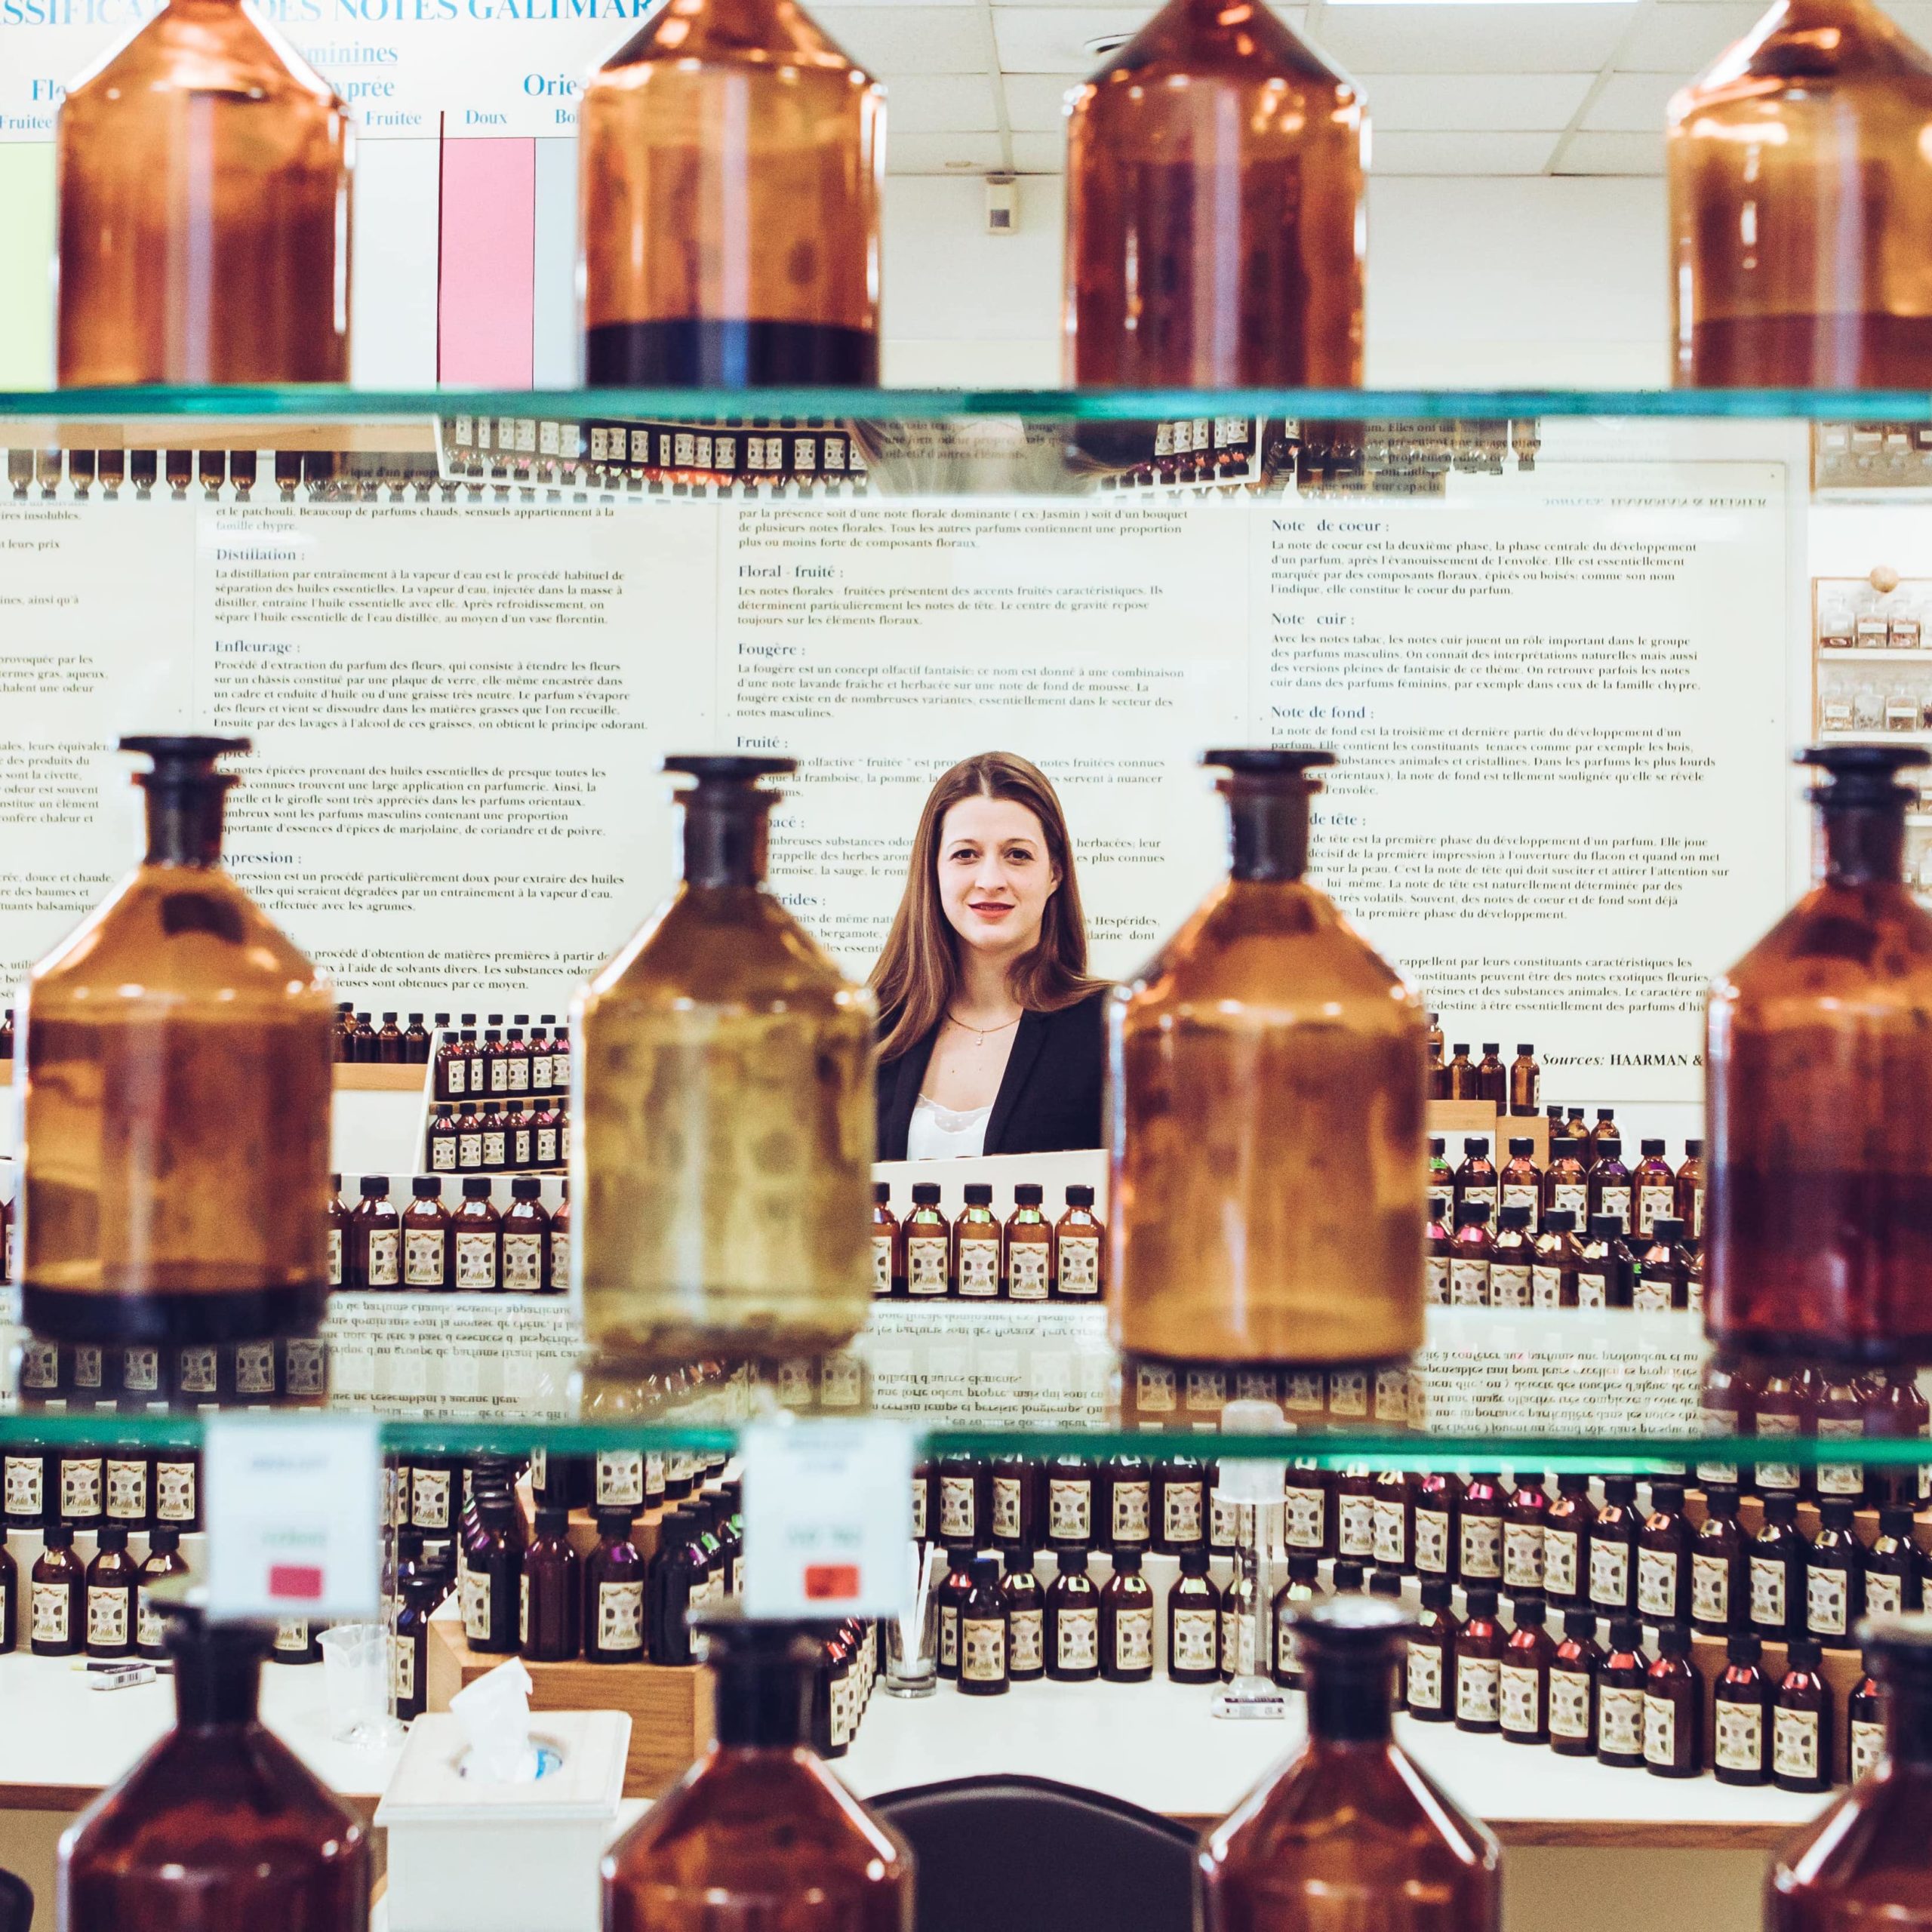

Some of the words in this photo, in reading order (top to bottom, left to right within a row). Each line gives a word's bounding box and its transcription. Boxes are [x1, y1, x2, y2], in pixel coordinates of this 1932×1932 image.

[334, 0, 458, 21] NOTES
[468, 0, 651, 20] GALIMAR
[306, 41, 398, 63] minines
[32, 79, 66, 101] Flo
[524, 74, 577, 96] Orie
[466, 109, 508, 125] Doux
[1272, 519, 1306, 531] Note
[1316, 518, 1335, 531] de
[1338, 522, 1381, 532] coeur
[8, 538, 35, 549] leurs
[38, 539, 60, 552] prix
[217, 548, 297, 561] Distillation
[215, 569, 228, 579] La
[230, 568, 289, 579] distillation
[292, 571, 312, 583] par
[390, 570, 397, 580] à
[400, 568, 410, 580] la
[412, 571, 451, 583] vapeur
[485, 571, 501, 580] est
[503, 570, 513, 580] le
[564, 570, 609, 580] habituel
[611, 570, 625, 580] de
[739, 564, 782, 577] Floral
[795, 565, 835, 577] fruité
[1326, 583, 1347, 594] elle
[1349, 585, 1401, 595] constitue
[1404, 584, 1414, 595] le
[1417, 586, 1449, 595] coeur
[1451, 584, 1466, 595] du
[27, 595, 54, 605] ainsi
[737, 615, 784, 627] toujours
[808, 614, 823, 625] les
[1272, 613, 1305, 625] Note
[1316, 612, 1347, 625] cuir
[215, 639, 293, 654] Enfleurage
[738, 643, 797, 659] Fougère
[57, 657, 76, 667] par
[78, 654, 94, 664] les
[1269, 678, 1293, 688] cuir
[1295, 677, 1322, 688] dans
[1324, 677, 1344, 688] des
[1347, 678, 1395, 691] parfums
[1454, 681, 1473, 692] par
[1475, 678, 1524, 692] exemple
[1527, 678, 1554, 690] dans
[1586, 679, 1600, 690] de
[1603, 678, 1613, 690] la
[1616, 678, 1655, 691] famille
[781, 693, 815, 703] existe
[817, 695, 832, 704] en
[834, 693, 848, 704] de
[851, 694, 919, 705] nombreuses
[979, 694, 1066, 706] essentiellement
[1069, 695, 1096, 707] dans
[1099, 696, 1109, 706] le
[1112, 698, 1152, 707] secteur
[1154, 696, 1174, 706] des
[736, 709, 767, 718] notes
[1271, 706, 1305, 718] Note
[1309, 705, 1327, 718] de
[1331, 706, 1365, 718] fond
[214, 718, 254, 728] Ensuite
[257, 720, 275, 731] par
[278, 717, 297, 728] des
[300, 718, 338, 731] lavages
[341, 720, 348, 728] à
[392, 718, 406, 728] de
[408, 721, 426, 729] ces
[496, 718, 535, 729] obtient
[538, 718, 549, 729] le
[551, 718, 598, 733] principe
[737, 736, 780, 749] Fruité
[6, 771, 29, 780] sont
[32, 769, 42, 780] la
[1139, 838, 1161, 848] leur
[1312, 833, 1326, 844] de
[1352, 835, 1368, 844] est
[1371, 833, 1381, 844] la
[1440, 834, 1473, 848] phase
[1475, 835, 1491, 846] du
[1660, 835, 1681, 848] Elle
[1684, 837, 1708, 850] joue
[223, 851, 293, 867] xpression
[25, 872, 57, 882] douce
[60, 874, 69, 882] et
[321, 903, 345, 911] avec
[349, 900, 364, 911] les
[1468, 987, 1478, 996] et
[1481, 986, 1501, 996] des
[1504, 985, 1565, 997] substances
[1625, 986, 1638, 997] Le
[1543, 1054, 1604, 1066] Sources:
[1611, 1054, 1687, 1066] HAARMAN
[1692, 1054, 1705, 1066] &
